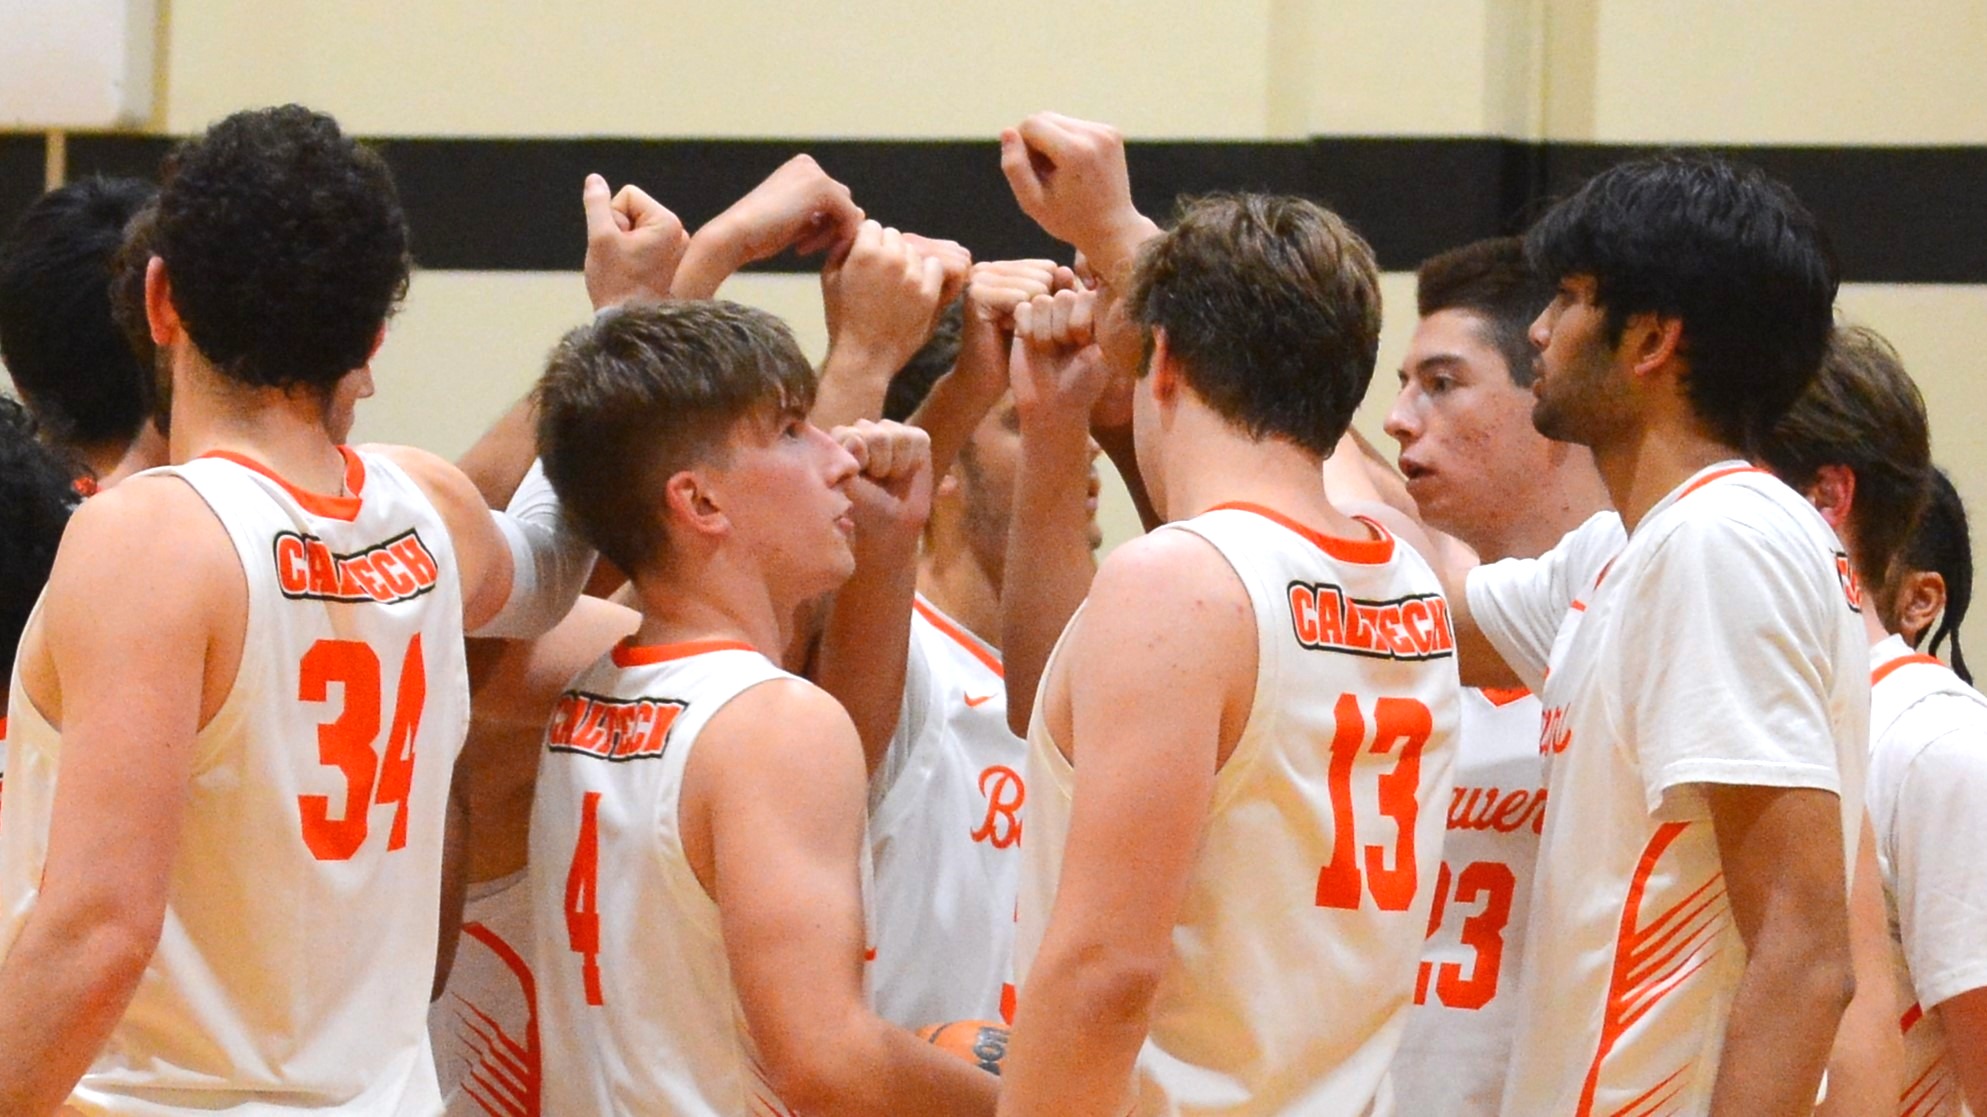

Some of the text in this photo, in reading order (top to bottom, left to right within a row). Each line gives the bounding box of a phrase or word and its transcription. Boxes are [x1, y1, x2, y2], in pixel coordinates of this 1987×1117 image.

[298, 632, 426, 861] 34
[1315, 692, 1432, 911] 13
[565, 791, 603, 1006] 4
